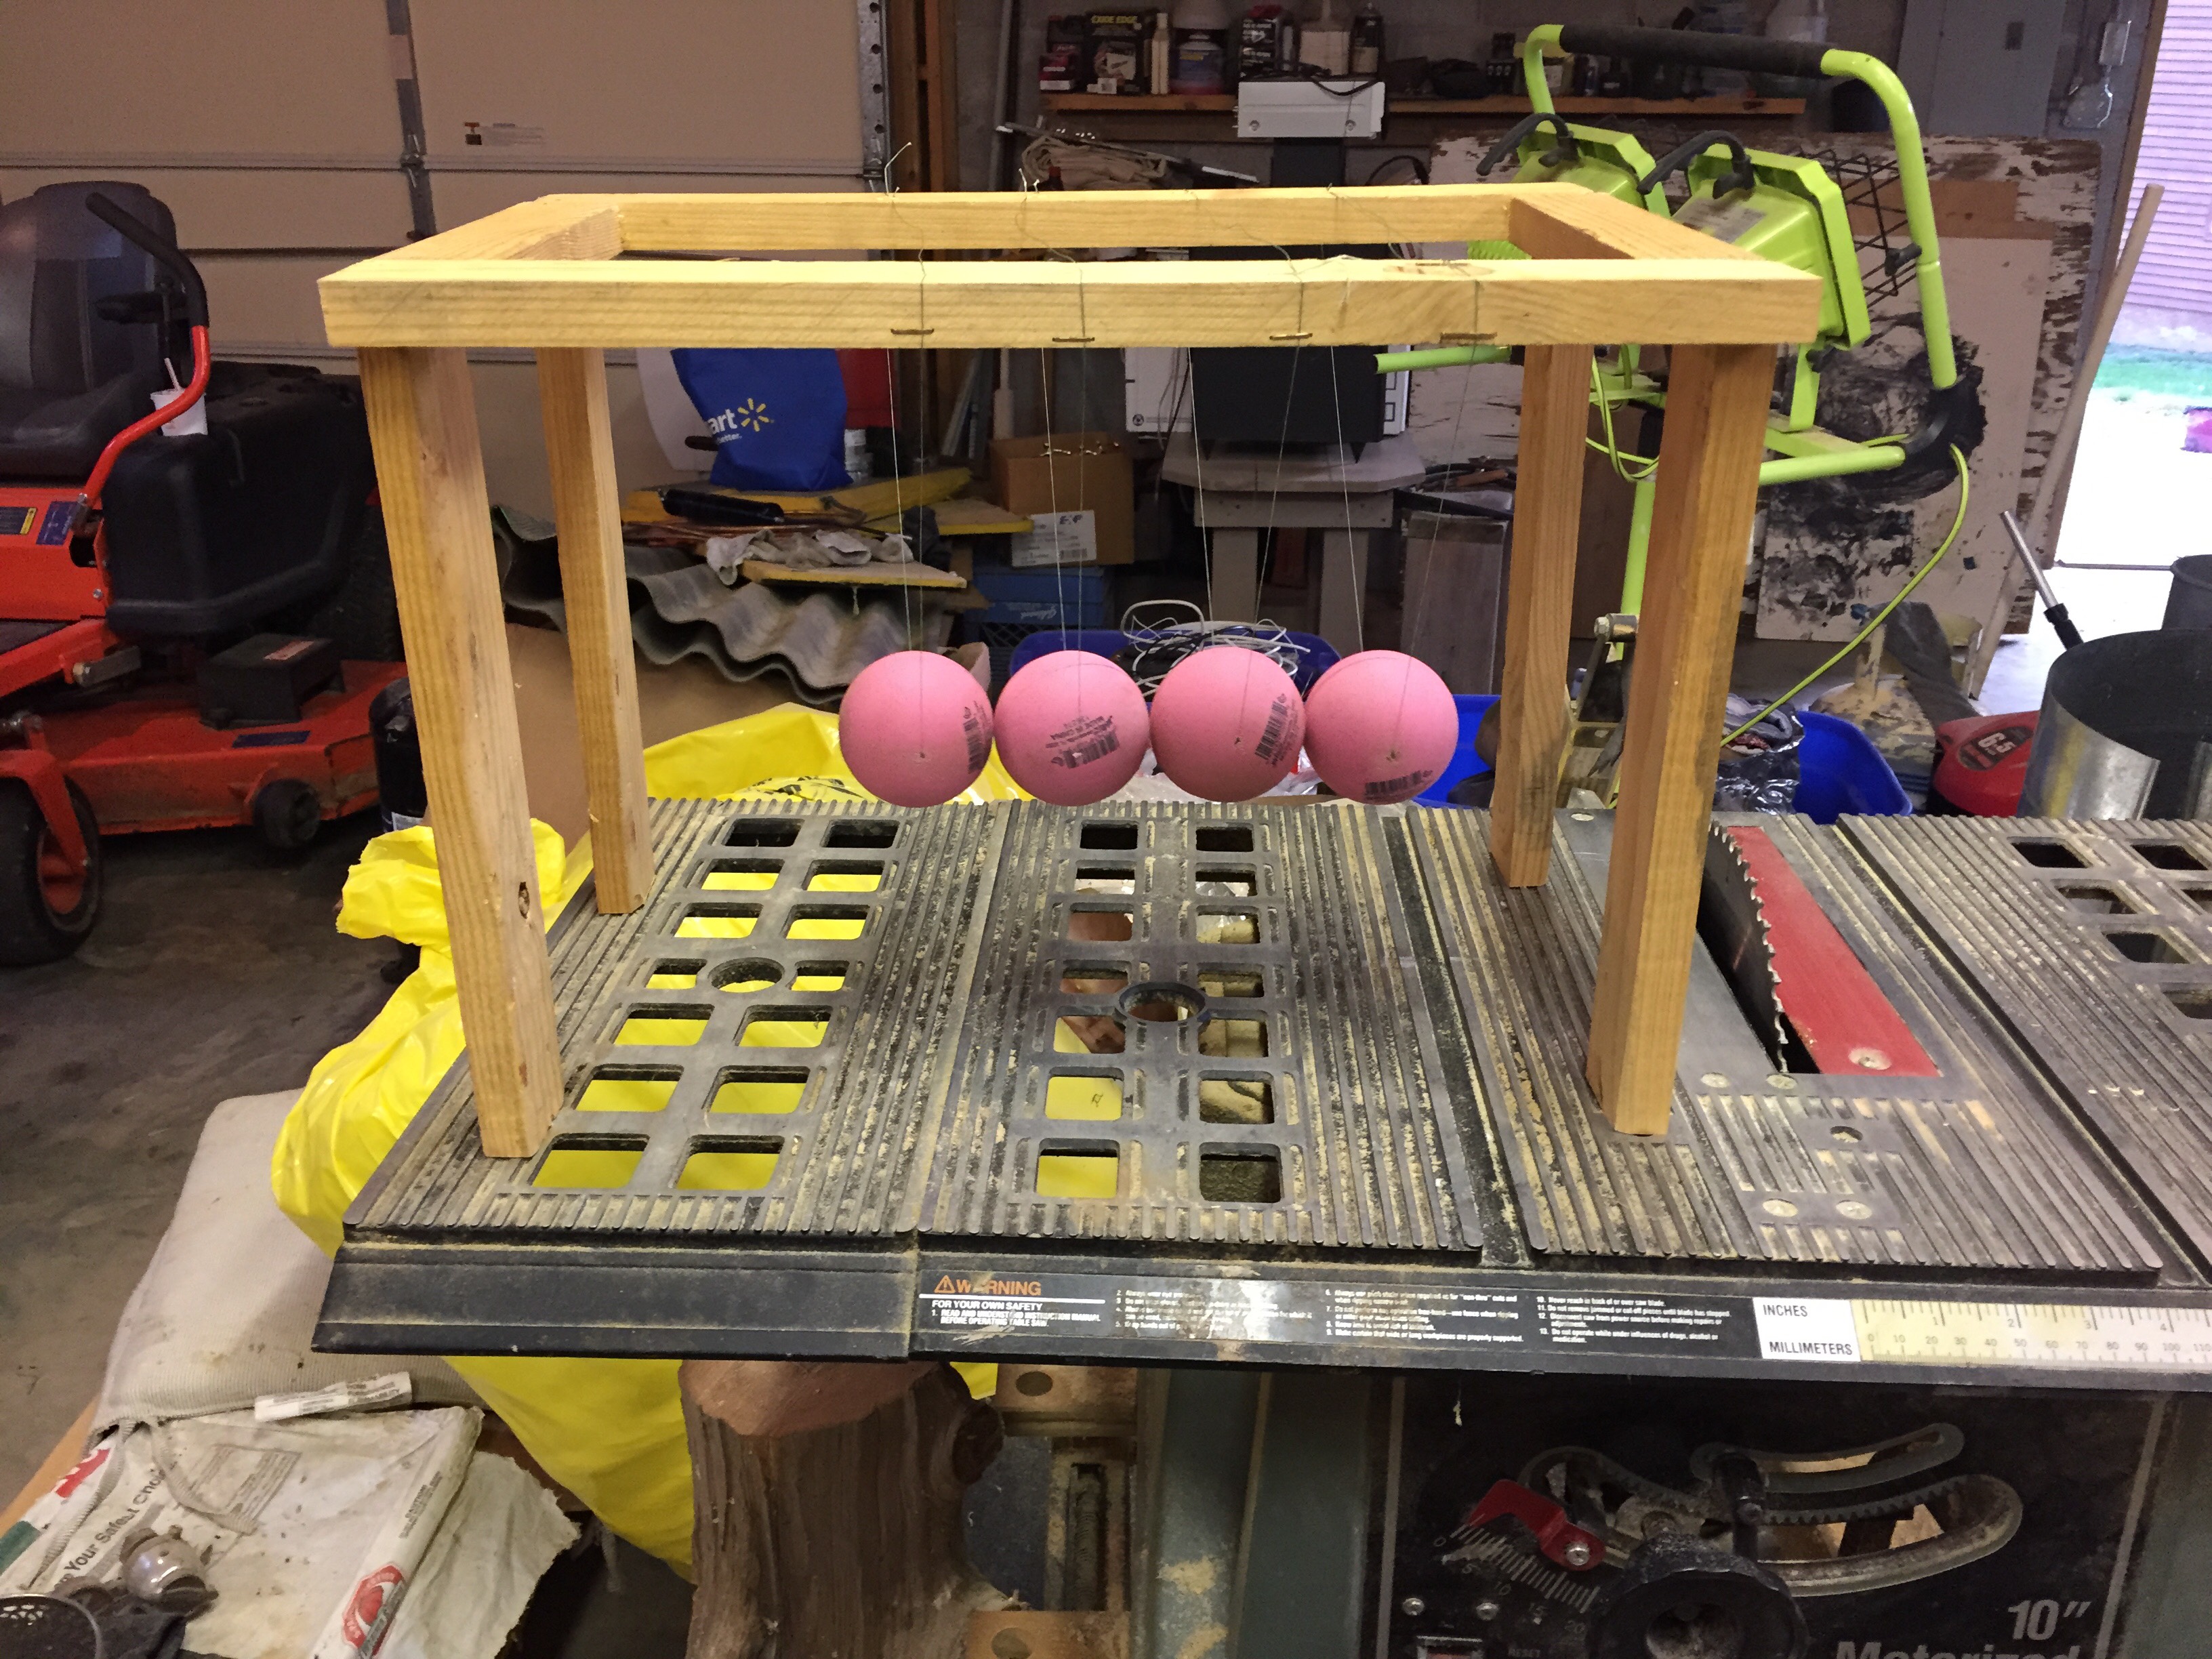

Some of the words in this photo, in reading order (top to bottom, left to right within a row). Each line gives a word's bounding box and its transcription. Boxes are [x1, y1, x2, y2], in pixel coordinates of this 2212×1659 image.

[1978, 733, 2017, 753] 6.5
[956, 1279, 1042, 1296] WRNING
[932, 1300, 951, 1309] FOR
[954, 1300, 981, 1309] YOUR
[981, 1301, 1004, 1310] OWN
[1006, 1302, 1043, 1311] SAFETY
[1763, 1304, 1808, 1317] INCHES
[1933, 1317, 1939, 1326] 1
[2007, 1318, 2015, 1328] 2
[2084, 1319, 2092, 1330] 3
[2160, 1323, 2167, 1332] 4
[1769, 1341, 1853, 1355] MILLIMETERS
[1868, 1333, 1875, 1343] 0
[1893, 1334, 1906, 1344] 10
[1925, 1336, 1938, 1345] 20
[1954, 1336, 1967, 1346] 30
[1984, 1338, 1998, 1347] 40
[2014, 1338, 2027, 1348] 50
[2045, 1340, 2060, 1349] 60
[2076, 1340, 2089, 1350] 70
[2106, 1341, 2120, 1351] 80
[2135, 1342, 2148, 1352] 90
[2163, 1343, 2182, 1352] 100
[64, 1544, 100, 1572] Your
